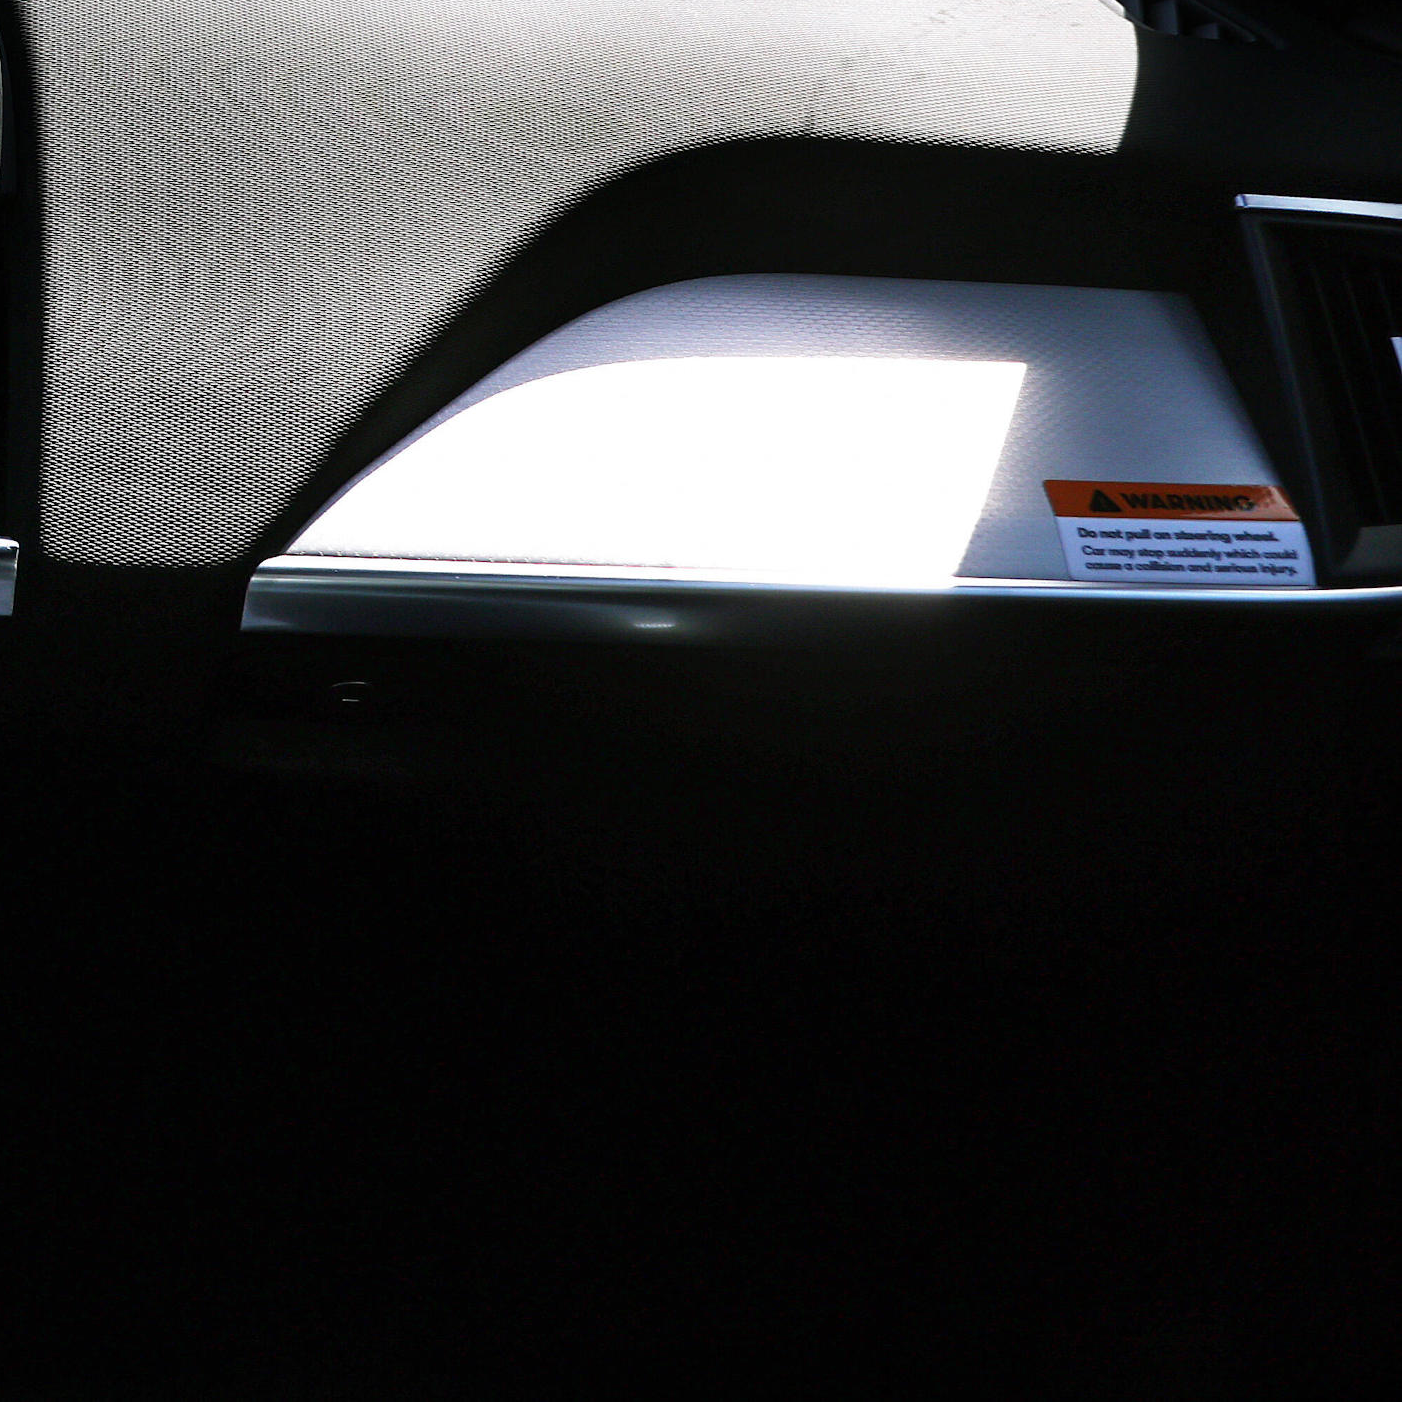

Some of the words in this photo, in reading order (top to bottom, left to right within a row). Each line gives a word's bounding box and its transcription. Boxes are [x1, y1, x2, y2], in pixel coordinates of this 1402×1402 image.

[1119, 492, 1255, 511] WARNING
[1077, 527, 1097, 539] Do
[1100, 529, 1124, 540] not
[1126, 529, 1151, 542] pull
[1154, 531, 1172, 541] on
[1174, 530, 1232, 544] steering
[1232, 531, 1280, 542] wheel.
[1082, 546, 1106, 557] Car
[1108, 548, 1135, 559] may
[1138, 548, 1164, 559] stop
[1168, 548, 1223, 561] suddenly
[1223, 549, 1260, 559] which
[1264, 549, 1299, 560] could
[1085, 562, 1122, 571] cause
[1124, 562, 1133, 571] a
[1136, 561, 1186, 572] collision
[1188, 562, 1212, 573] and
[1215, 563, 1258, 573] serious
[1261, 564, 1298, 576] injury.
